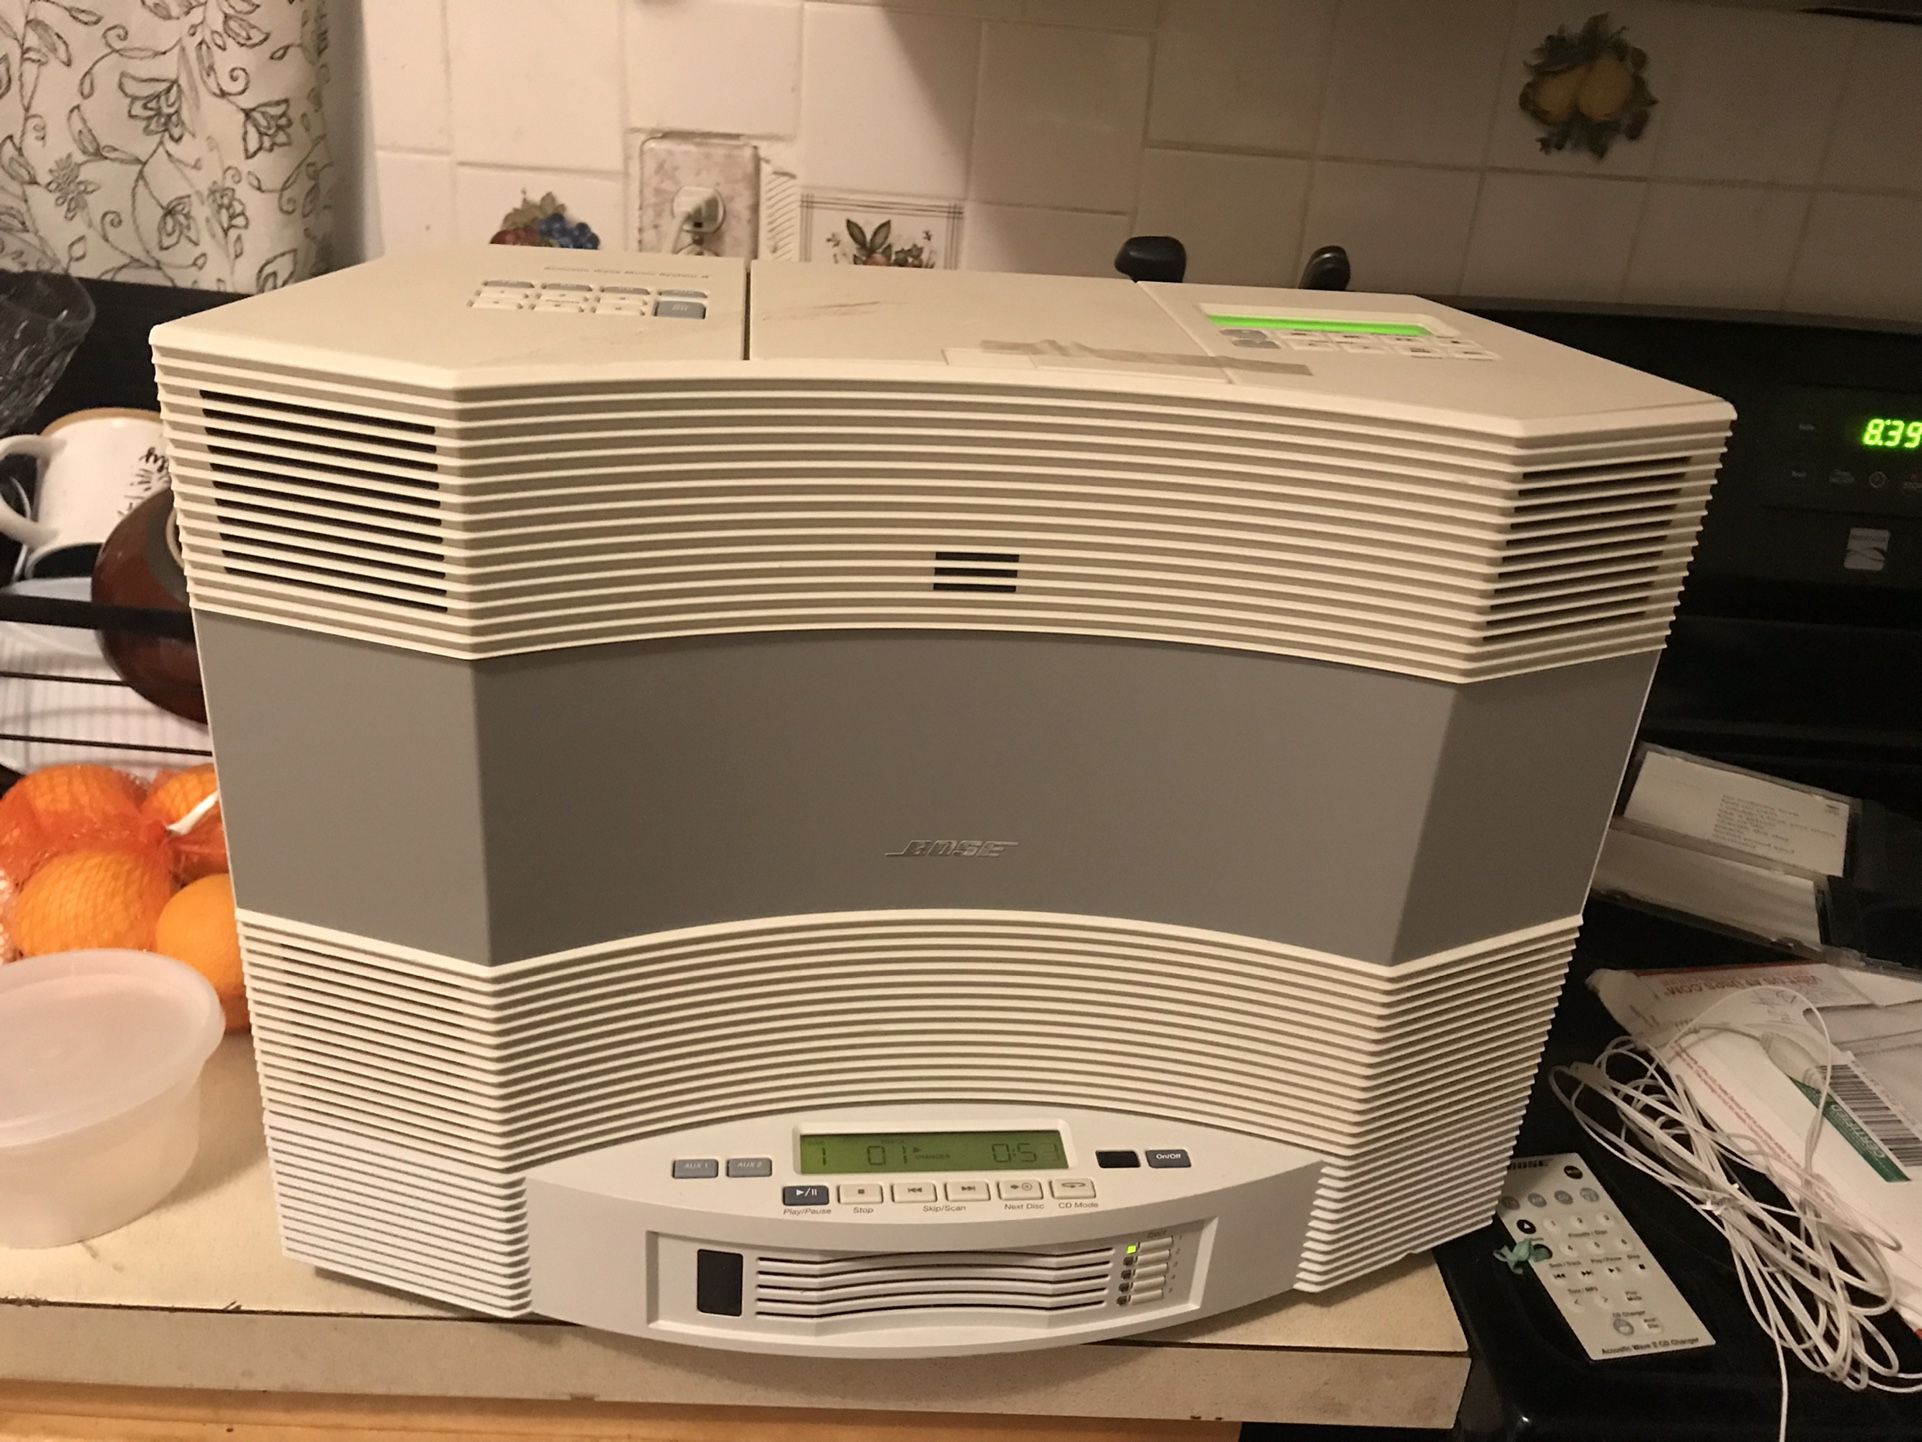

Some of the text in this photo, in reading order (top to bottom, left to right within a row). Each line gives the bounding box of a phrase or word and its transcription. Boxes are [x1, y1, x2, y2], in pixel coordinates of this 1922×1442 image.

[884, 839, 1019, 858] BOSE
[1155, 1153, 1182, 1161] On/Off
[922, 1204, 966, 1213] Skip/Scan
[1004, 1203, 1024, 1211] Next
[1074, 1201, 1099, 1209] Mode
[783, 1207, 832, 1216] Play/Pause
[853, 1206, 874, 1215] Stop
